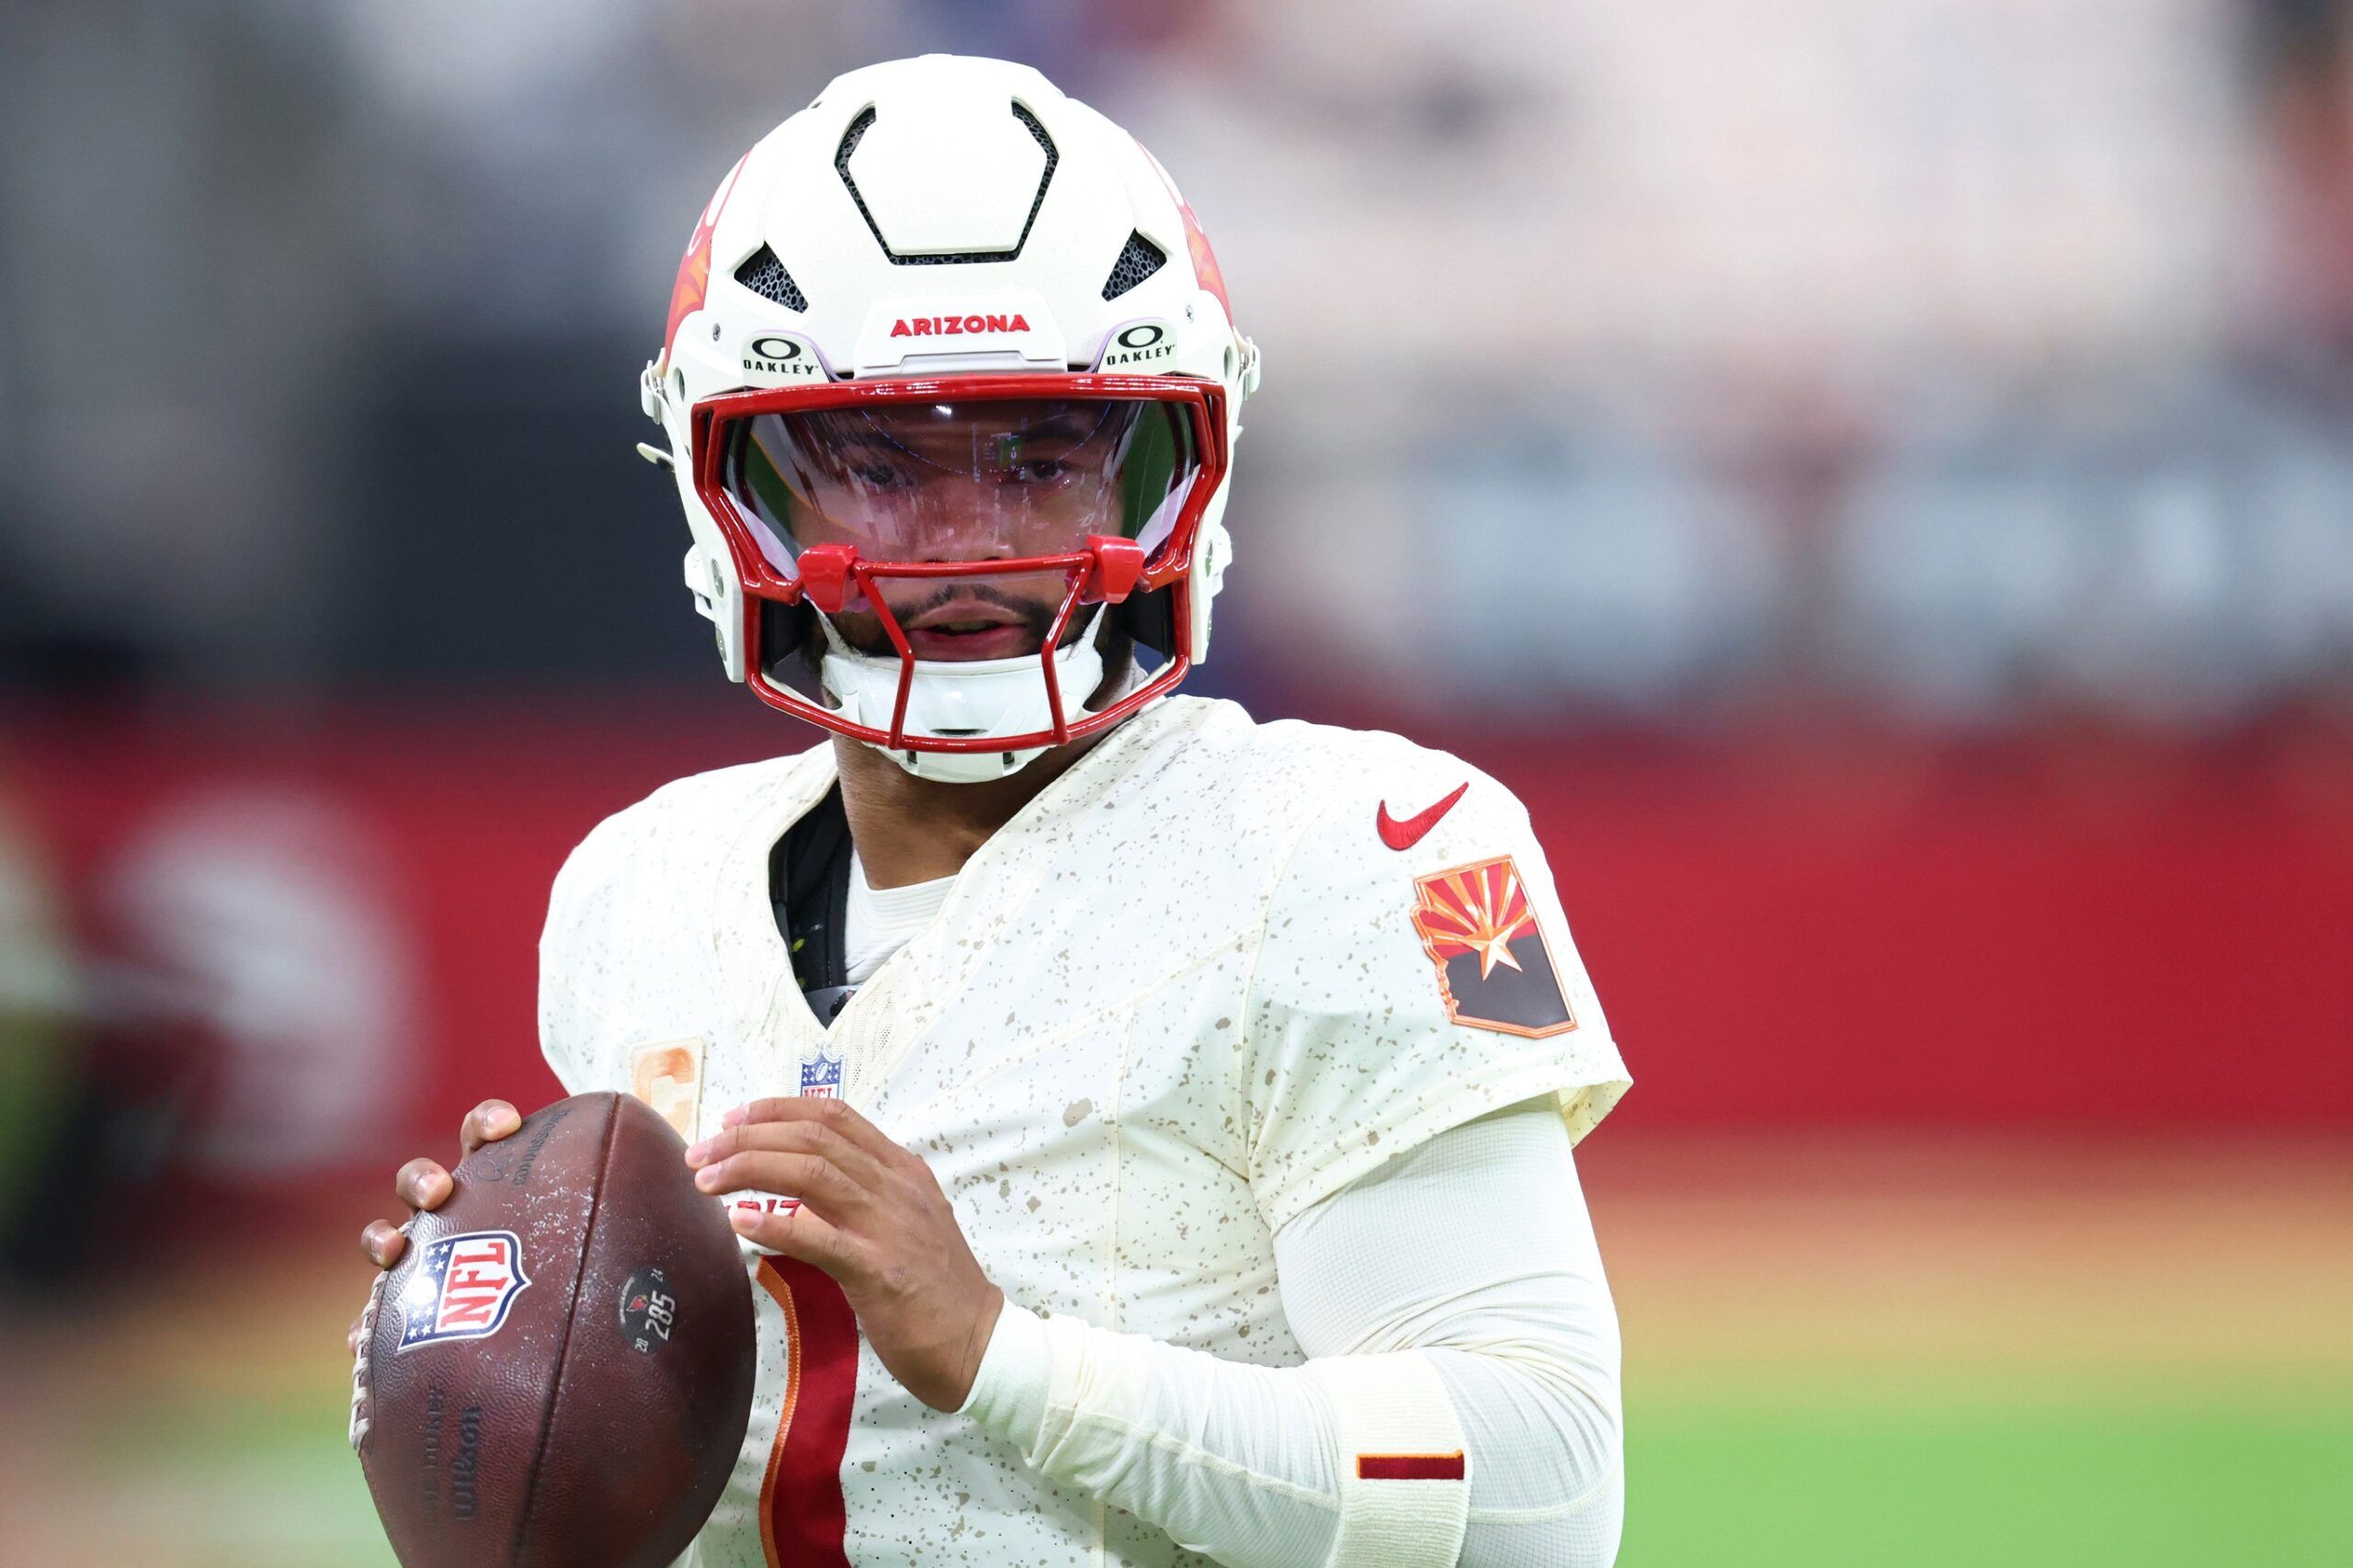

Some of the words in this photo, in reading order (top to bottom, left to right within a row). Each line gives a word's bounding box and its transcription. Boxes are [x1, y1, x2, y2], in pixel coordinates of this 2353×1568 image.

[890, 313, 1030, 337] ARIZONA
[1107, 345, 1173, 365] OAKLEY
[743, 359, 814, 375] OAKLEY
[439, 1242, 508, 1329] NFL
[651, 1268, 664, 1283] 24
[645, 1289, 676, 1342] 285
